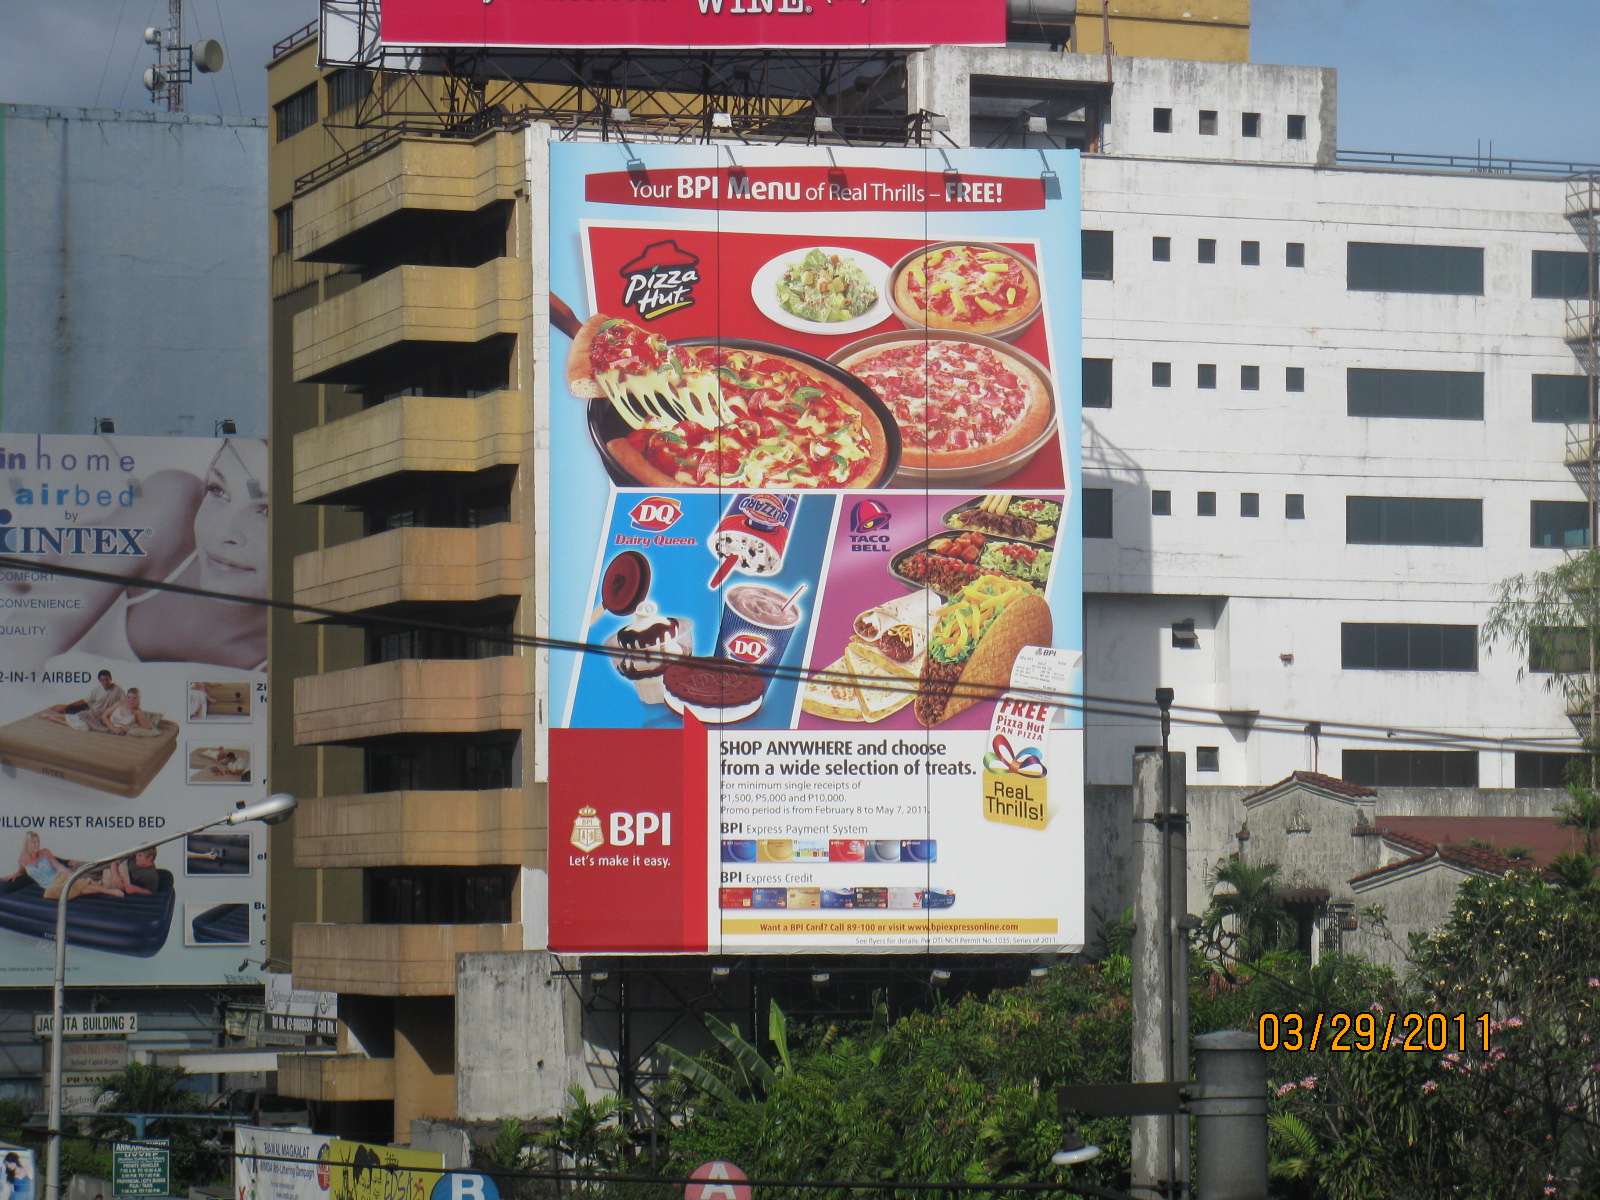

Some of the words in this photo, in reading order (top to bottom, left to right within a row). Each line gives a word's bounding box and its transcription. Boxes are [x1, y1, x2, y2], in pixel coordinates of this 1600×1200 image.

[630, 180, 673, 199] Your
[677, 176, 718, 200] BPI
[727, 176, 802, 200] Menu
[805, 182, 826, 201] of
[829, 183, 868, 202] Real
[870, 183, 925, 203] Thrills
[945, 182, 1003, 204] FREE!
[624, 268, 698, 305] Pizza
[638, 286, 685, 314] Hut
[37, 434, 136, 471] home
[15, 483, 135, 506] airbed
[64, 510, 79, 522] by
[638, 503, 676, 522] DQ
[740, 498, 789, 523] BLIZZARD
[615, 535, 651, 548] Dairy
[654, 535, 697, 547] Queen
[849, 535, 890, 543] TACO
[851, 544, 890, 552] BELL
[0, 571, 58, 583] COMFORT.
[0, 599, 85, 609] CONVENIENCE.
[0, 626, 49, 637] QUALITY.
[734, 639, 761, 657] DQ
[1042, 649, 1057, 657] BPI
[0, 672, 37, 683] 2-IN-1
[42, 672, 92, 684] AIRBED
[999, 697, 1050, 722] FREE
[996, 715, 1024, 730] Pizza
[1027, 721, 1046, 735] Hut
[995, 725, 1014, 736] PAN
[1016, 729, 1043, 742] PIZZA
[720, 741, 762, 756] SHOP
[766, 741, 853, 756] ANYWHERE
[857, 740, 887, 756] and
[891, 740, 947, 756] choose
[721, 759, 760, 776] from
[764, 763, 775, 776] a
[780, 759, 821, 776] wide
[825, 759, 900, 776] selection
[903, 759, 921, 776] of
[924, 761, 977, 776] treats.
[721, 781, 736, 790] For
[737, 781, 782, 790] minimum
[784, 781, 811, 792] single
[813, 781, 850, 792] receipts
[851, 781, 862, 790] of
[788, 793, 806, 802] and
[721, 806, 750, 815] Promo
[752, 805, 781, 816] period
[783, 805, 790, 814] is
[791, 805, 813, 814] from
[816, 805, 854, 816] February
[856, 806, 862, 814] 8
[864, 806, 873, 814] to
[875, 806, 894, 816] May
[896, 806, 905, 816] 7,
[986, 796, 1044, 822] Thrills!
[50, 816, 82, 828] REST
[85, 816, 136, 828] RAISED
[139, 816, 166, 828] BED
[609, 811, 671, 847] BPI
[720, 823, 742, 834] BPI
[746, 824, 783, 836] Express
[786, 824, 829, 836] Payment
[833, 824, 868, 836] System
[569, 855, 595, 867] Let's
[598, 855, 629, 867] make
[632, 856, 641, 867] it
[643, 857, 671, 869] easy.
[720, 871, 742, 883] BPI
[746, 873, 782, 885] Express
[785, 872, 813, 883] Credit
[760, 923, 781, 931] Want
[790, 923, 803, 931] BPI
[805, 923, 828, 931] Card?
[830, 923, 845, 931] Call
[847, 923, 875, 931] 89-100
[888, 923, 905, 931] visit
[907, 923, 1019, 933] www.bpiexpressonline.com
[868, 937, 885, 945] flyers
[83, 1016, 125, 1031] BUILDING
[130, 1016, 136, 1030] 2
